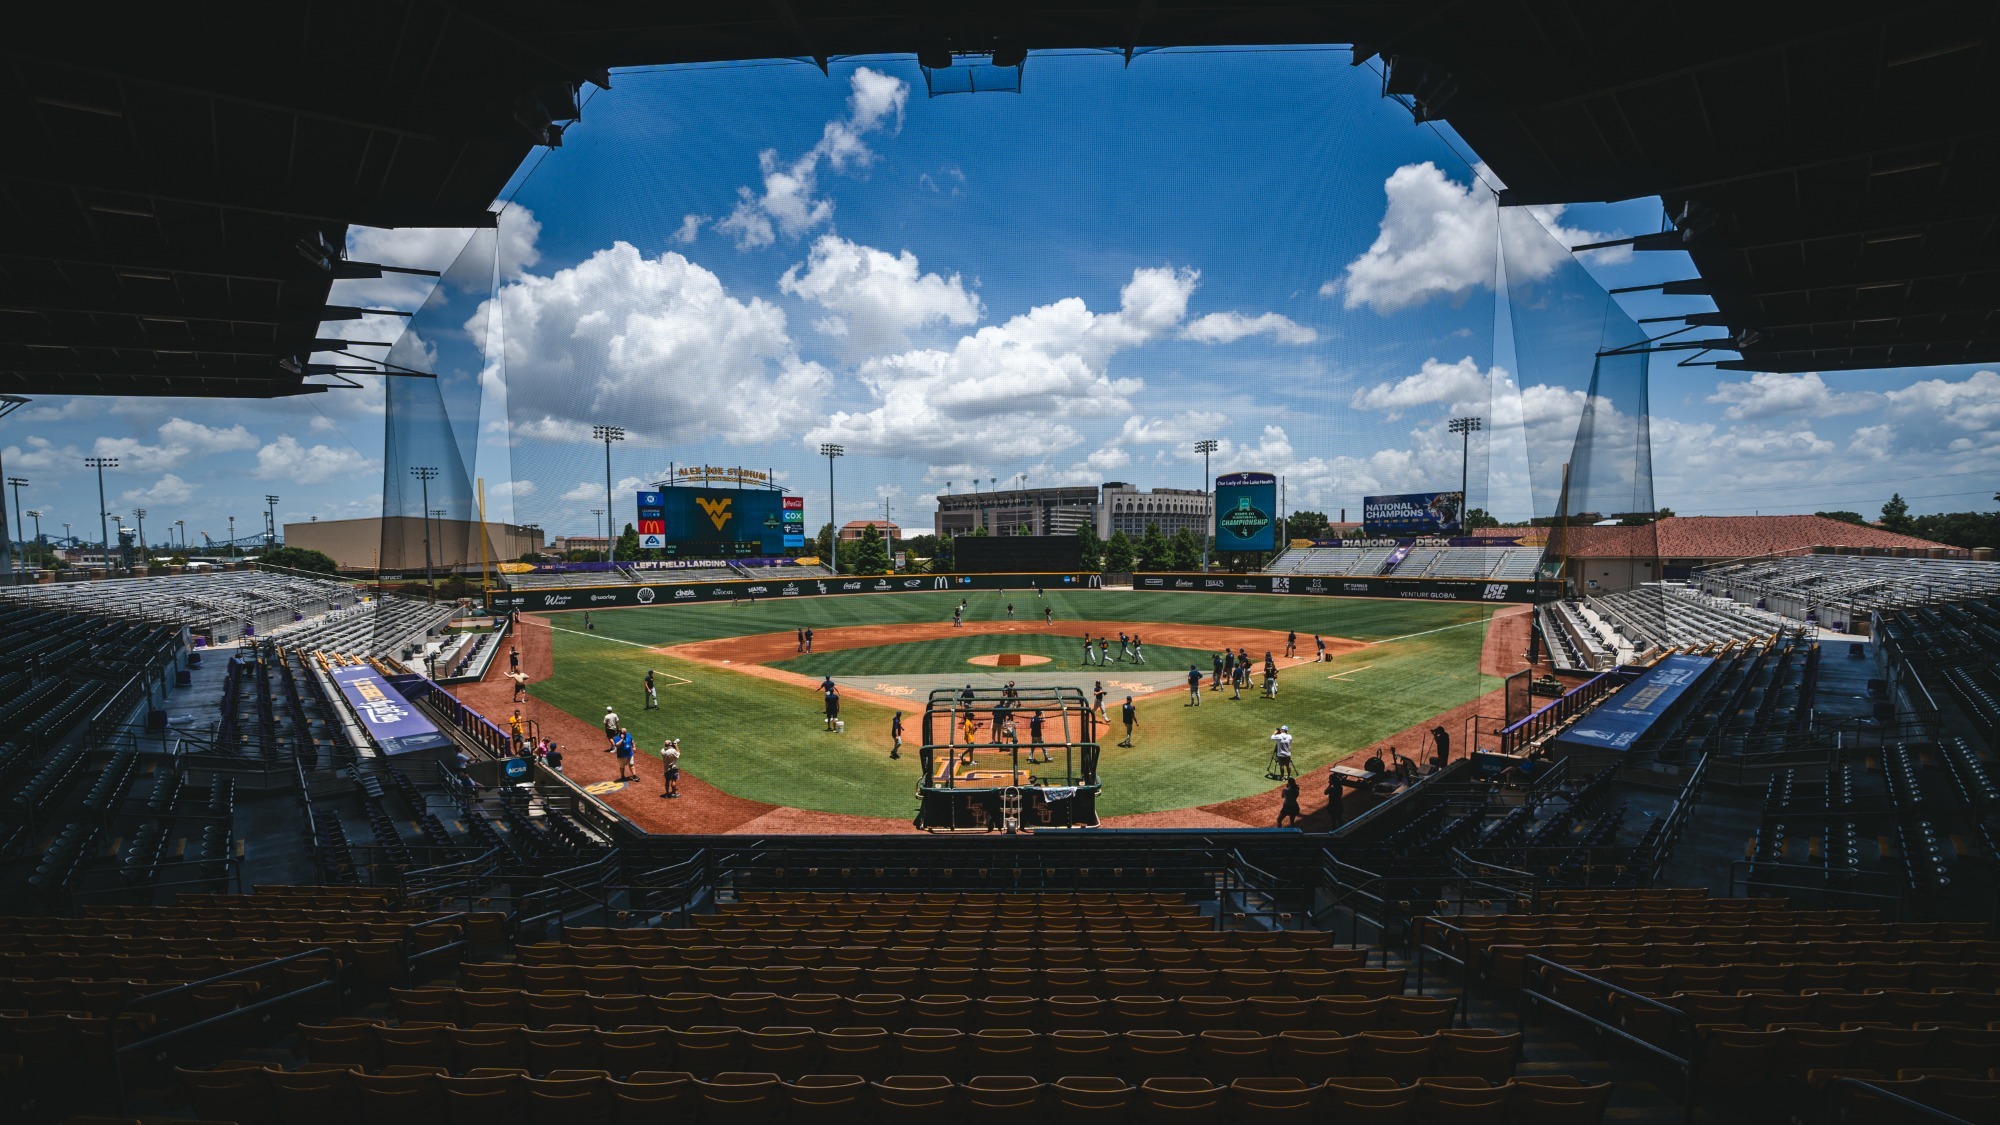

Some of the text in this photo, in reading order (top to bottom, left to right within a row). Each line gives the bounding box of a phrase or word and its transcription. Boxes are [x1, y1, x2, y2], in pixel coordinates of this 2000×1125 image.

[679, 467, 766, 480] ALEX BOX STADIUM
[1366, 502, 1413, 511] NATIONAL
[1366, 509, 1424, 519] CHAMPIONS
[1221, 518, 1268, 526] CHAMPIONSHIP
[1342, 538, 1451, 547] DIAMOND DECK
[634, 560, 727, 569] LEFT FIELD LANDING
[1272, 577, 1290, 588] H&E
[1482, 584, 1509, 599] ISC
[508, 766, 527, 774] NCAA
[966, 796, 987, 824] LSU
[1032, 795, 1054, 823] LSU
